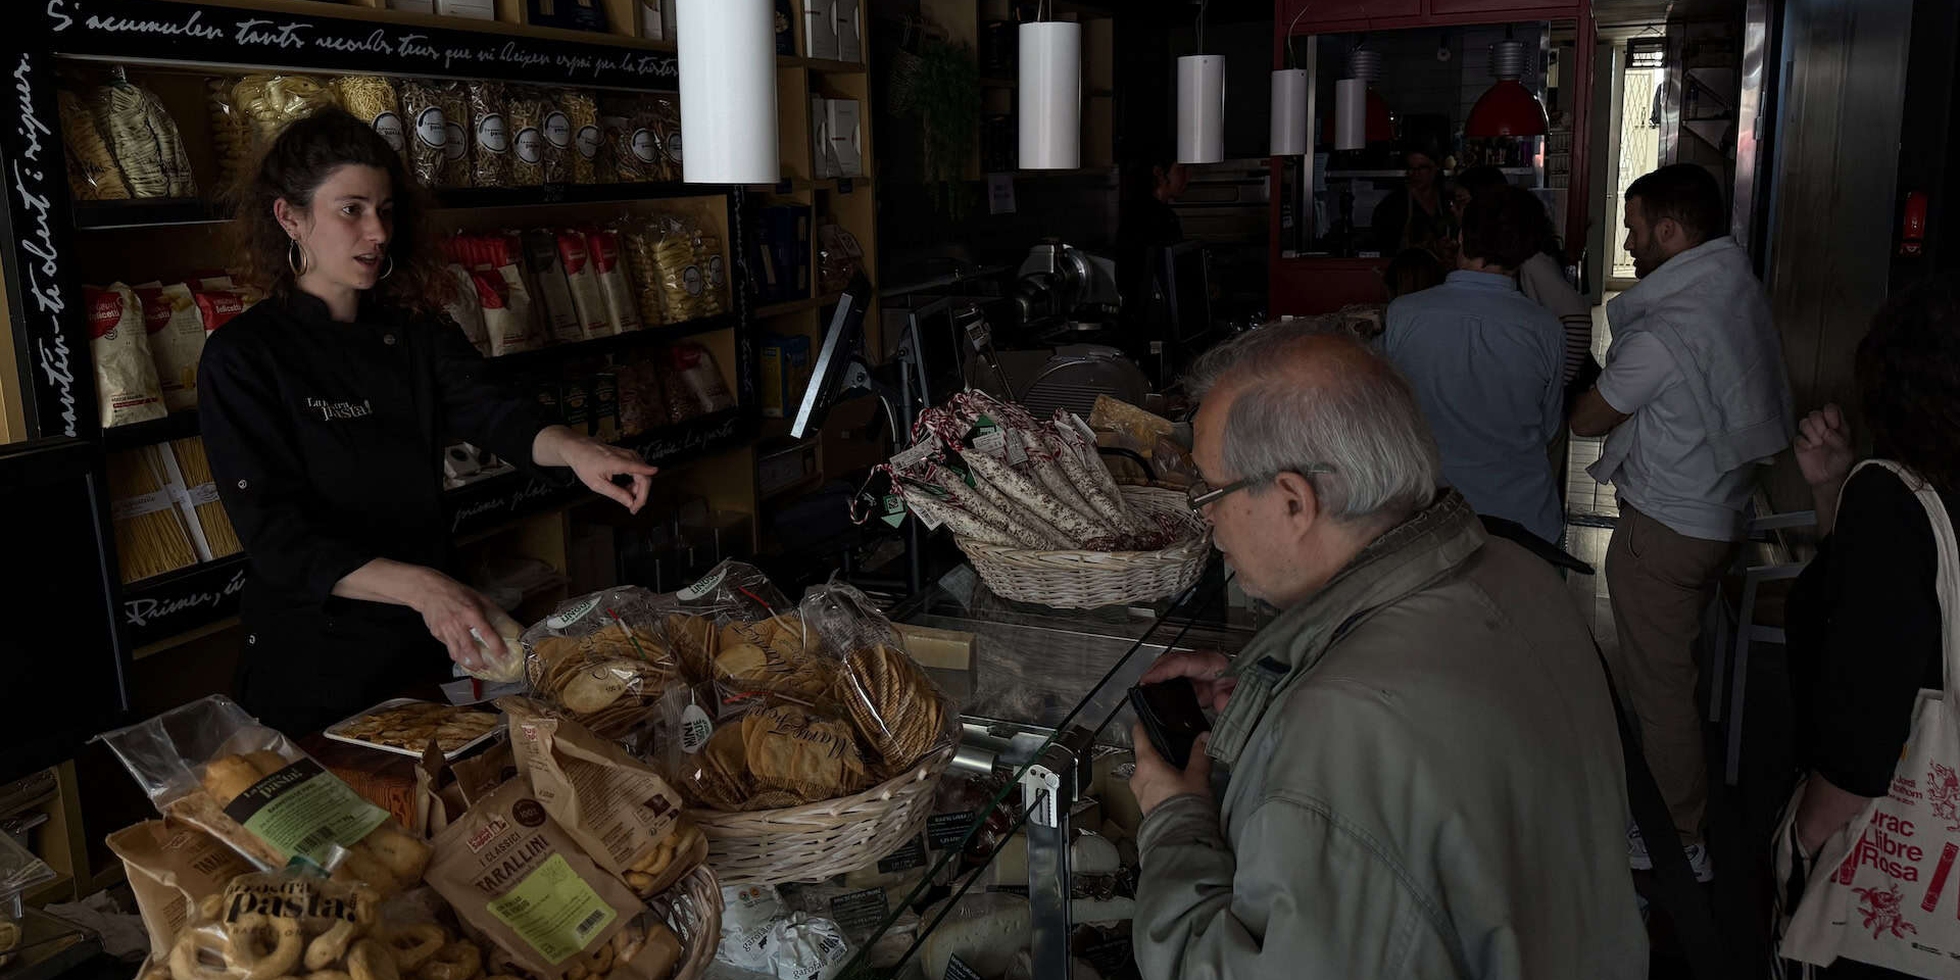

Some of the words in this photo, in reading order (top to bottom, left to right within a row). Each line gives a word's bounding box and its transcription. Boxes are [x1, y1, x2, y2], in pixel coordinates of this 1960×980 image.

[482, 830, 523, 863] CLASSICI
[1863, 829, 1923, 862] Llibre
[475, 834, 550, 895] TARALLINI
[1861, 845, 1919, 882] Rosa
[227, 893, 358, 923] pasta!
